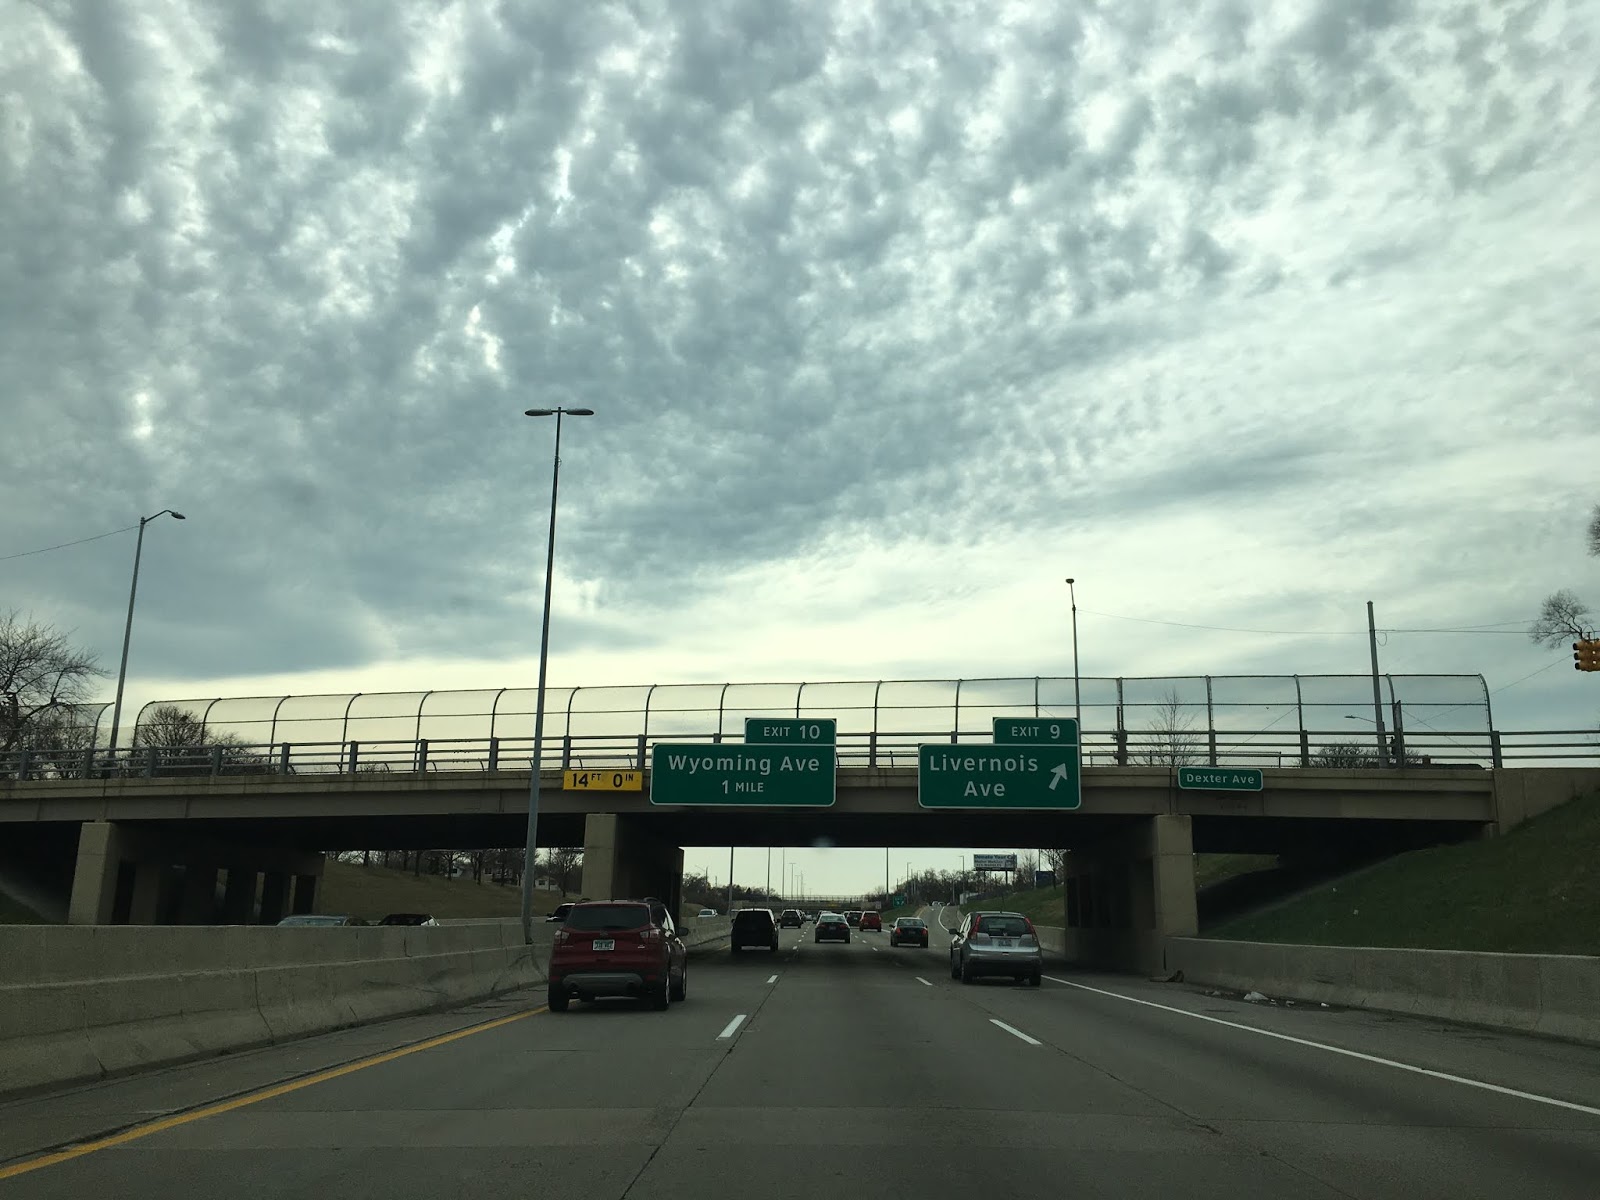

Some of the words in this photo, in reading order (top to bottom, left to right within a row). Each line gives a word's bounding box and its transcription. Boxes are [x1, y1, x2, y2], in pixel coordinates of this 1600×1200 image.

[763, 726, 790, 737] EXIT
[799, 725, 820, 740] 10
[1011, 726, 1040, 737] EXIT
[1050, 725, 1061, 739] 9
[668, 754, 771, 775] Wyoming
[780, 756, 820, 772] Ave
[929, 754, 1038, 772] Livernois
[572, 773, 589, 788] 14
[591, 773, 601, 781] FT
[613, 773, 623, 788] 0
[625, 773, 634, 782] IN
[1186, 773, 1227, 784] Dexter
[1232, 775, 1255, 784] Ave
[722, 780, 729, 794] 1
[735, 782, 764, 793] MILE
[964, 781, 1006, 797] Ave
